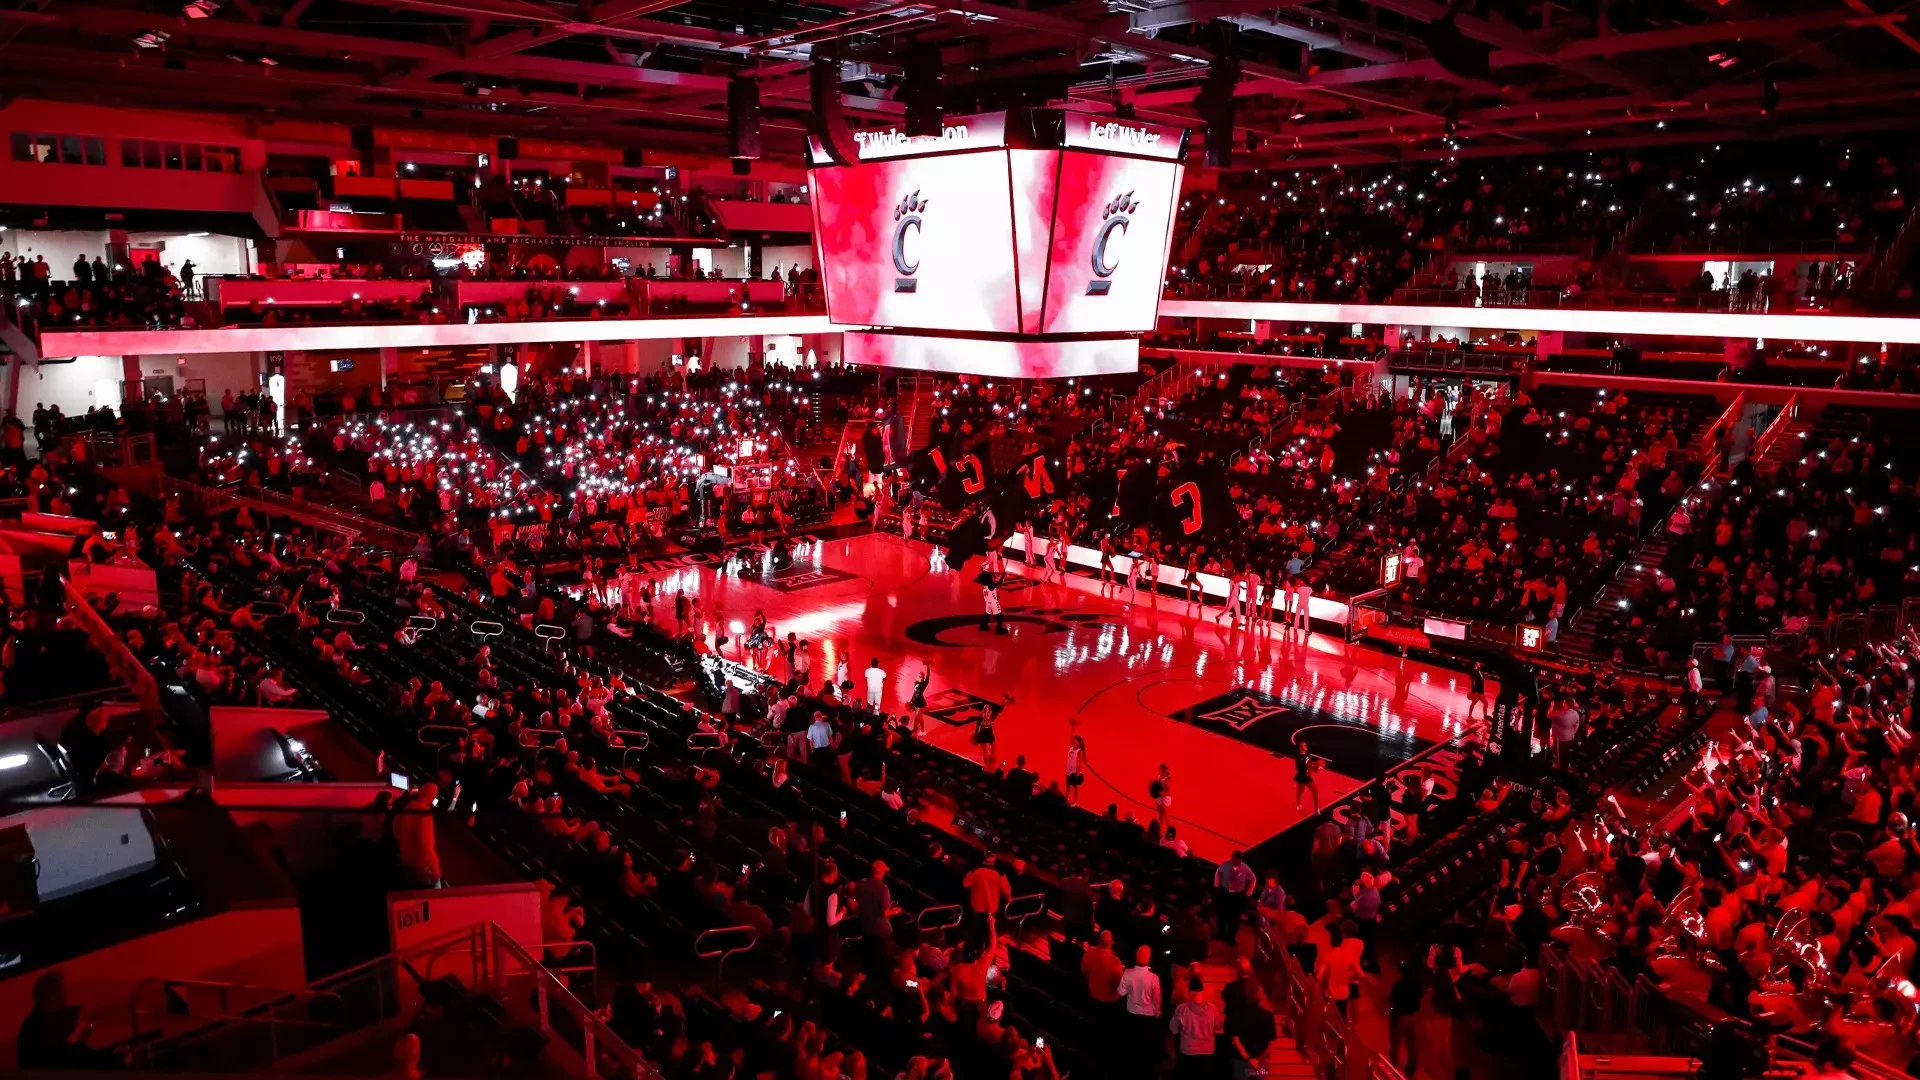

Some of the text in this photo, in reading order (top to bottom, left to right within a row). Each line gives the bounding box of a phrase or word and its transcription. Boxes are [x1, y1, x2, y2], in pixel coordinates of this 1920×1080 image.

[866, 127, 909, 151] Wyle
[1088, 121, 1161, 147] Jeff Wyler
[399, 234, 420, 242] THE
[425, 235, 482, 243] MARGARET
[512, 237, 554, 245] MICHAEL
[560, 239, 610, 247] VALENTINE
[613, 240, 651, 248] INCLINE
[518, 522, 550, 533] STUDENT
[1494, 703, 1507, 740] Ameritas
